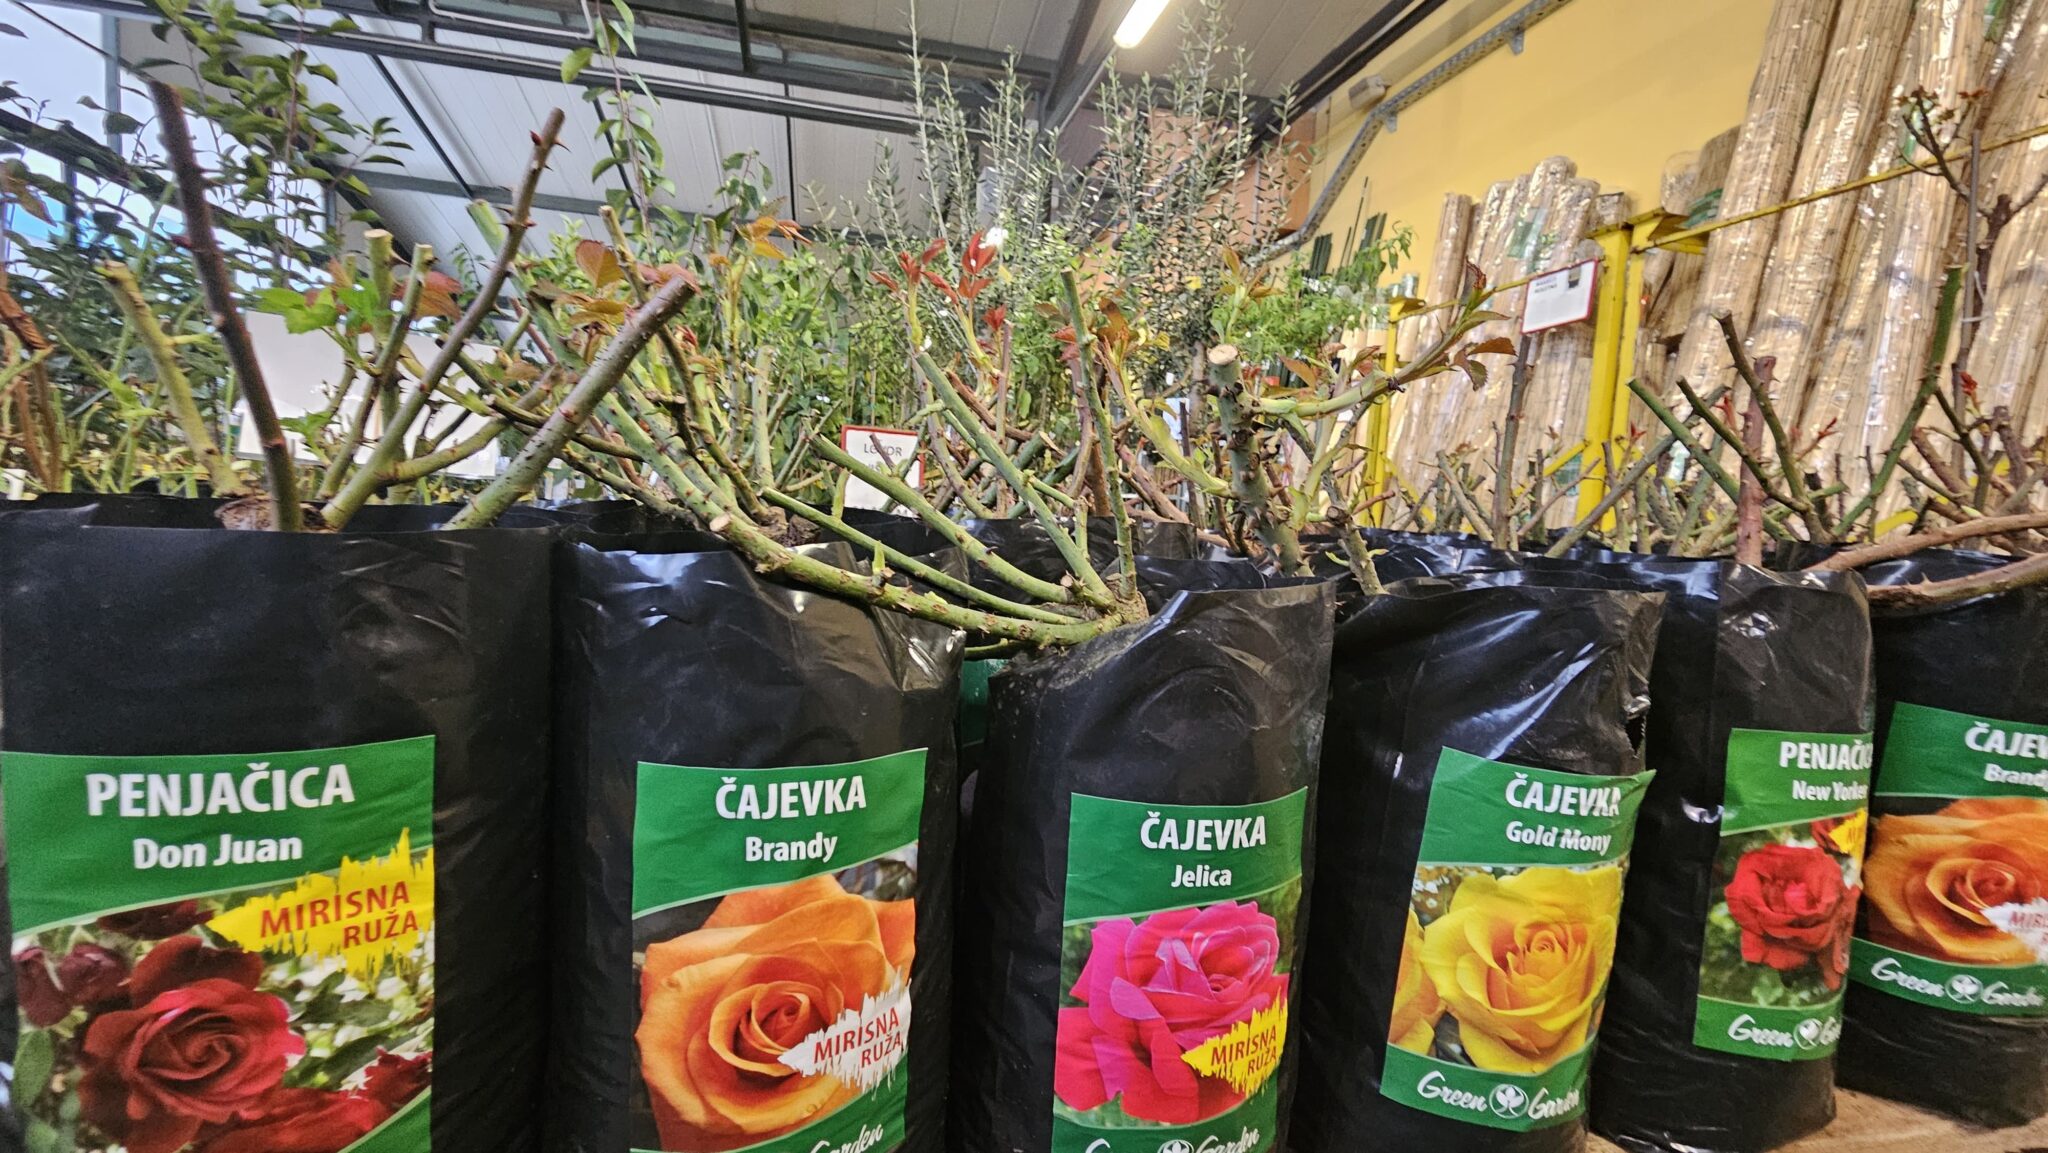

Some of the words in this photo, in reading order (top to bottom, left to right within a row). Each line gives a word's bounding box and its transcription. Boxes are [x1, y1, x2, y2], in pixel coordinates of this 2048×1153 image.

[863, 443, 902, 457] LOOR
[85, 761, 355, 818] PENJAČICA
[715, 775, 867, 820] ČAJEVKA
[1505, 771, 1621, 817] ČAJEVKA
[1792, 779, 1831, 801] New
[745, 832, 838, 863] Brandy
[1140, 811, 1266, 851] ČAJEVKA
[1505, 820, 1558, 848] Gold
[1559, 828, 1611, 856] Mony
[133, 838, 206, 870] Don
[213, 834, 302, 867] Juan
[1170, 864, 1232, 888] Jelica
[260, 880, 410, 938] MIRISNA
[342, 910, 419, 949] RUŽA
[1871, 957, 1945, 998] Green
[814, 1007, 899, 1064] MIRISNA
[861, 1030, 902, 1068] RUŽA
[1211, 1025, 1277, 1067] MIRISNA
[1247, 1046, 1277, 1076] RUŽA
[1417, 1070, 1488, 1112] Green
[809, 1124, 884, 1153] rden
